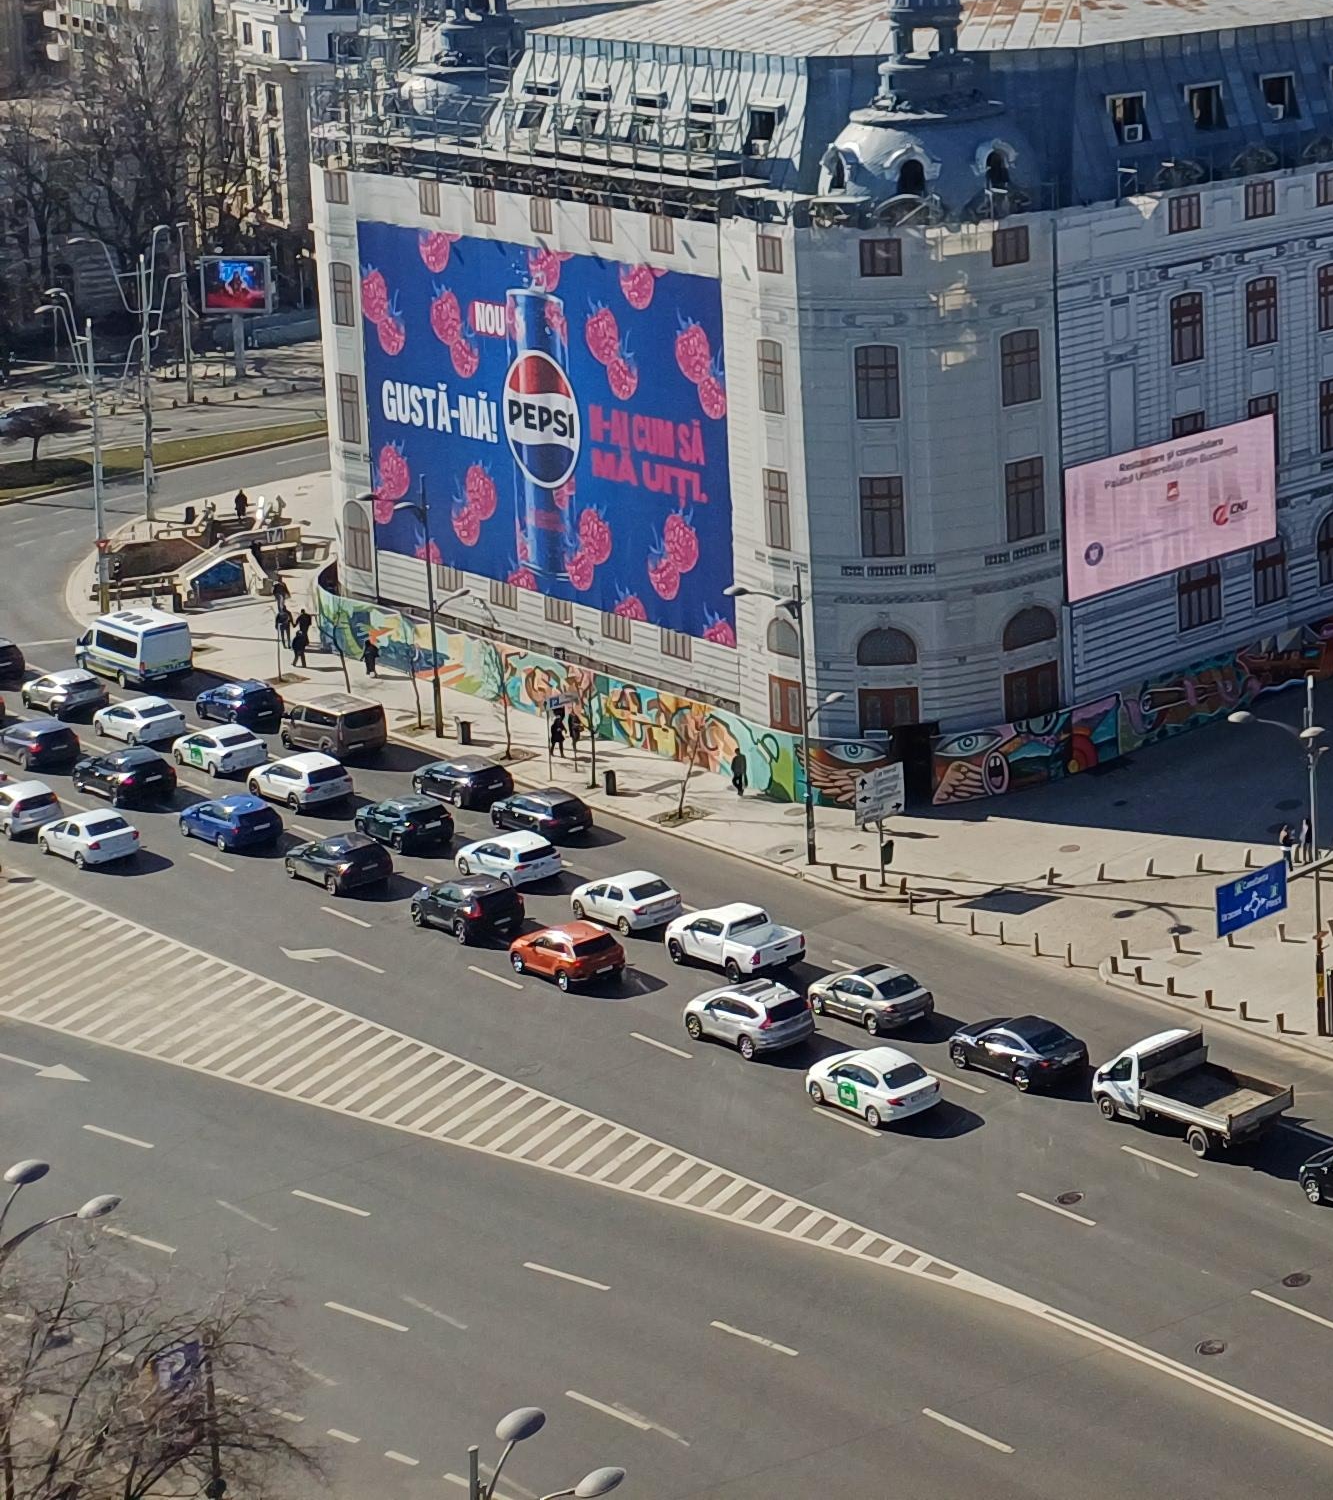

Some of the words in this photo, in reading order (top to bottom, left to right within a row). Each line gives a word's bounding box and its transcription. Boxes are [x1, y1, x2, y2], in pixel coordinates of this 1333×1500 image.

[474, 301, 506, 336] NOU
[382, 380, 499, 443] GUSTĂ-MĂ!
[508, 399, 575, 440] PEPSI
[632, 414, 675, 458] CUM
[677, 419, 705, 466] SĂ
[591, 448, 638, 486] MĂ
